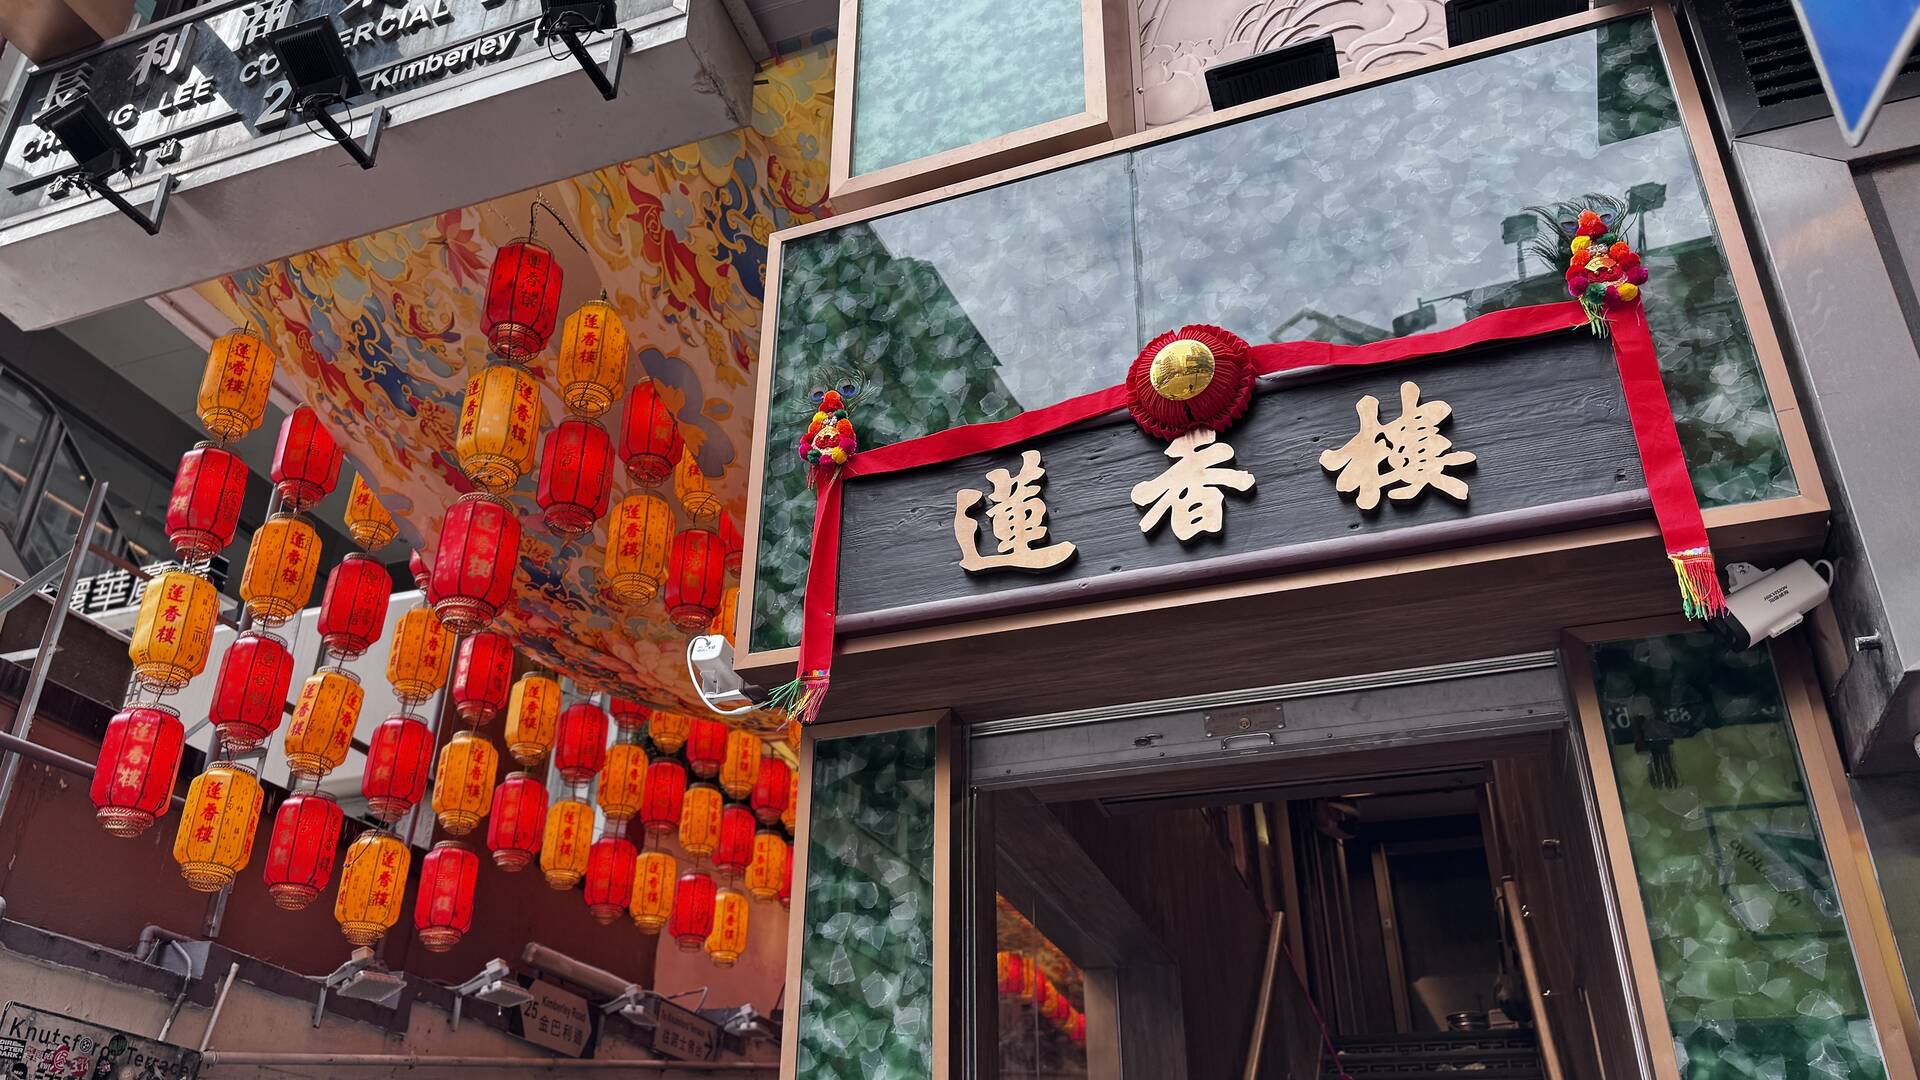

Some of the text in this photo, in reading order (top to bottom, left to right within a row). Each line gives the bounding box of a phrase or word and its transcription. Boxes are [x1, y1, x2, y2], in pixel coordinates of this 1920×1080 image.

[158, 75, 214, 111] LEE
[239, 0, 449, 83] COERCIAL
[370, 31, 516, 91] Kimberley
[578, 313, 599, 364] 蓮香樓
[225, 343, 251, 394] 蓮香樓
[511, 381, 534, 447] 蓮香樓
[953, 380, 1477, 573] 蓮香樓
[282, 531, 304, 585] 蓮香樓
[620, 504, 642, 561] 蓮香樓
[156, 583, 186, 645] 蓮香樓
[194, 781, 222, 844] 蓮香樓
[372, 851, 397, 908] 蓮香樓
[524, 1000, 539, 1019] 25
[9, 1017, 113, 1060] Knutsfrd
